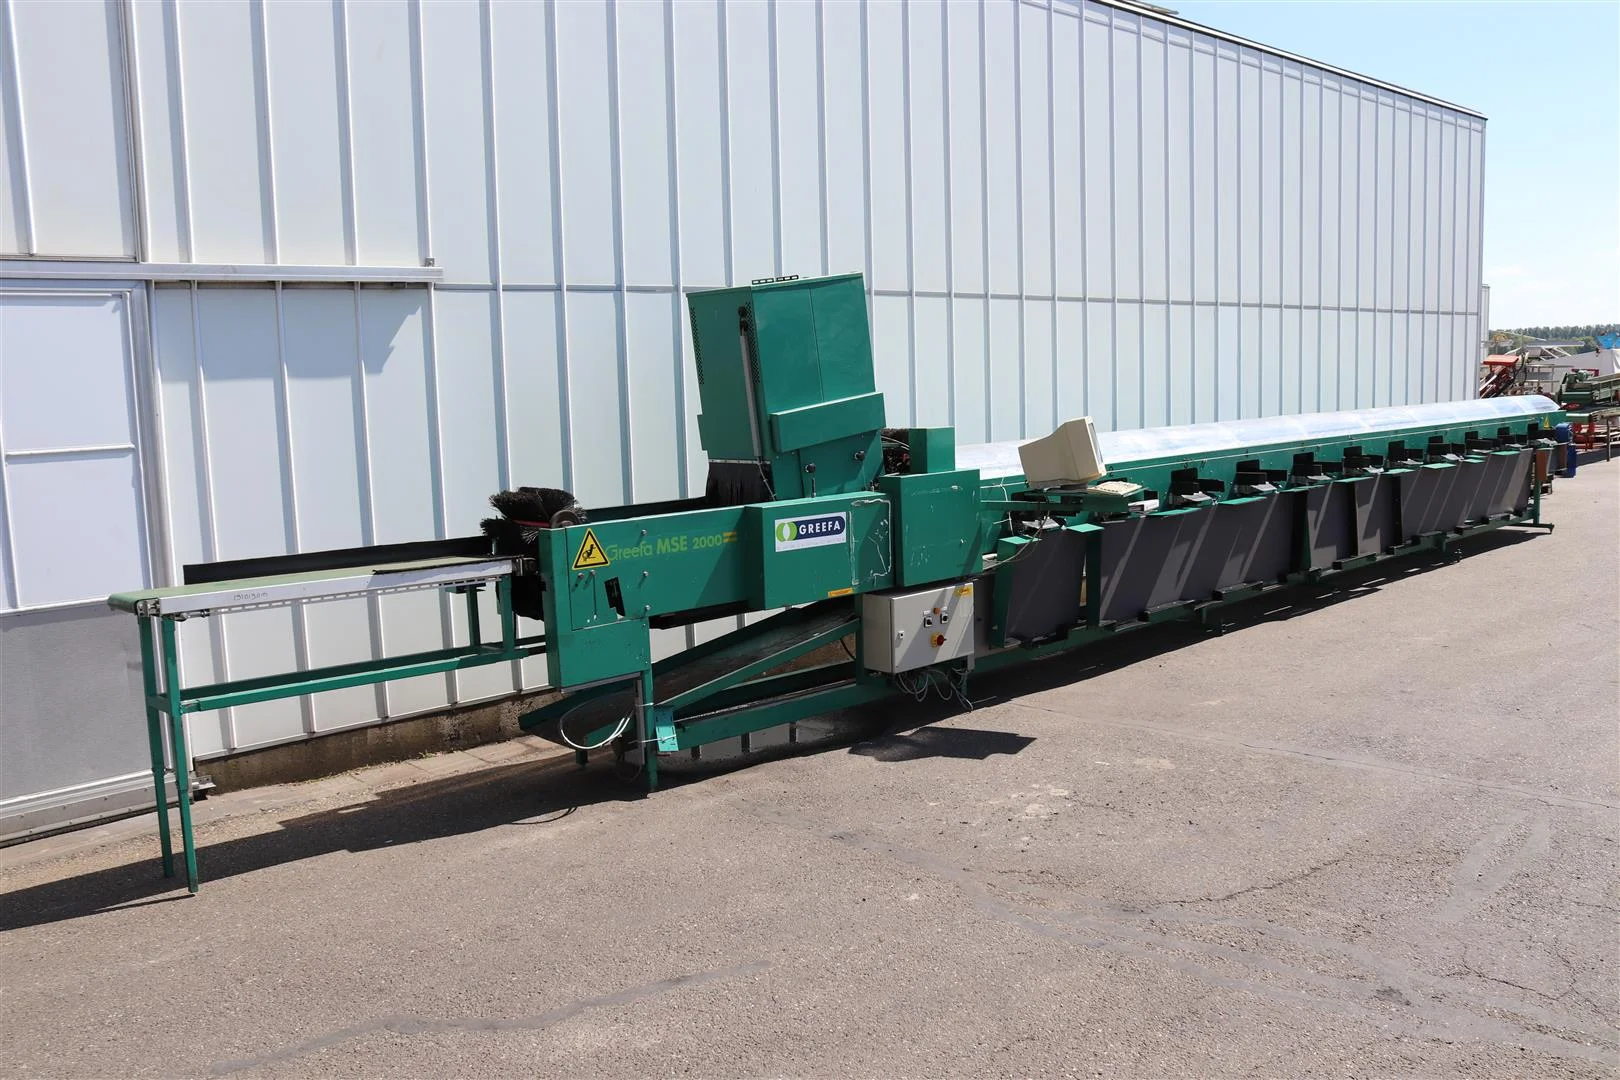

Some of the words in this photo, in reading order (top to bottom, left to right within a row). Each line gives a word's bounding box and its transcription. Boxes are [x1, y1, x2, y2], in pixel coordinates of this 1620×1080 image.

[799, 520, 841, 535] GREEFA
[605, 541, 653, 561] Greefa
[657, 535, 688, 554] MSE
[692, 534, 722, 549] 2000
